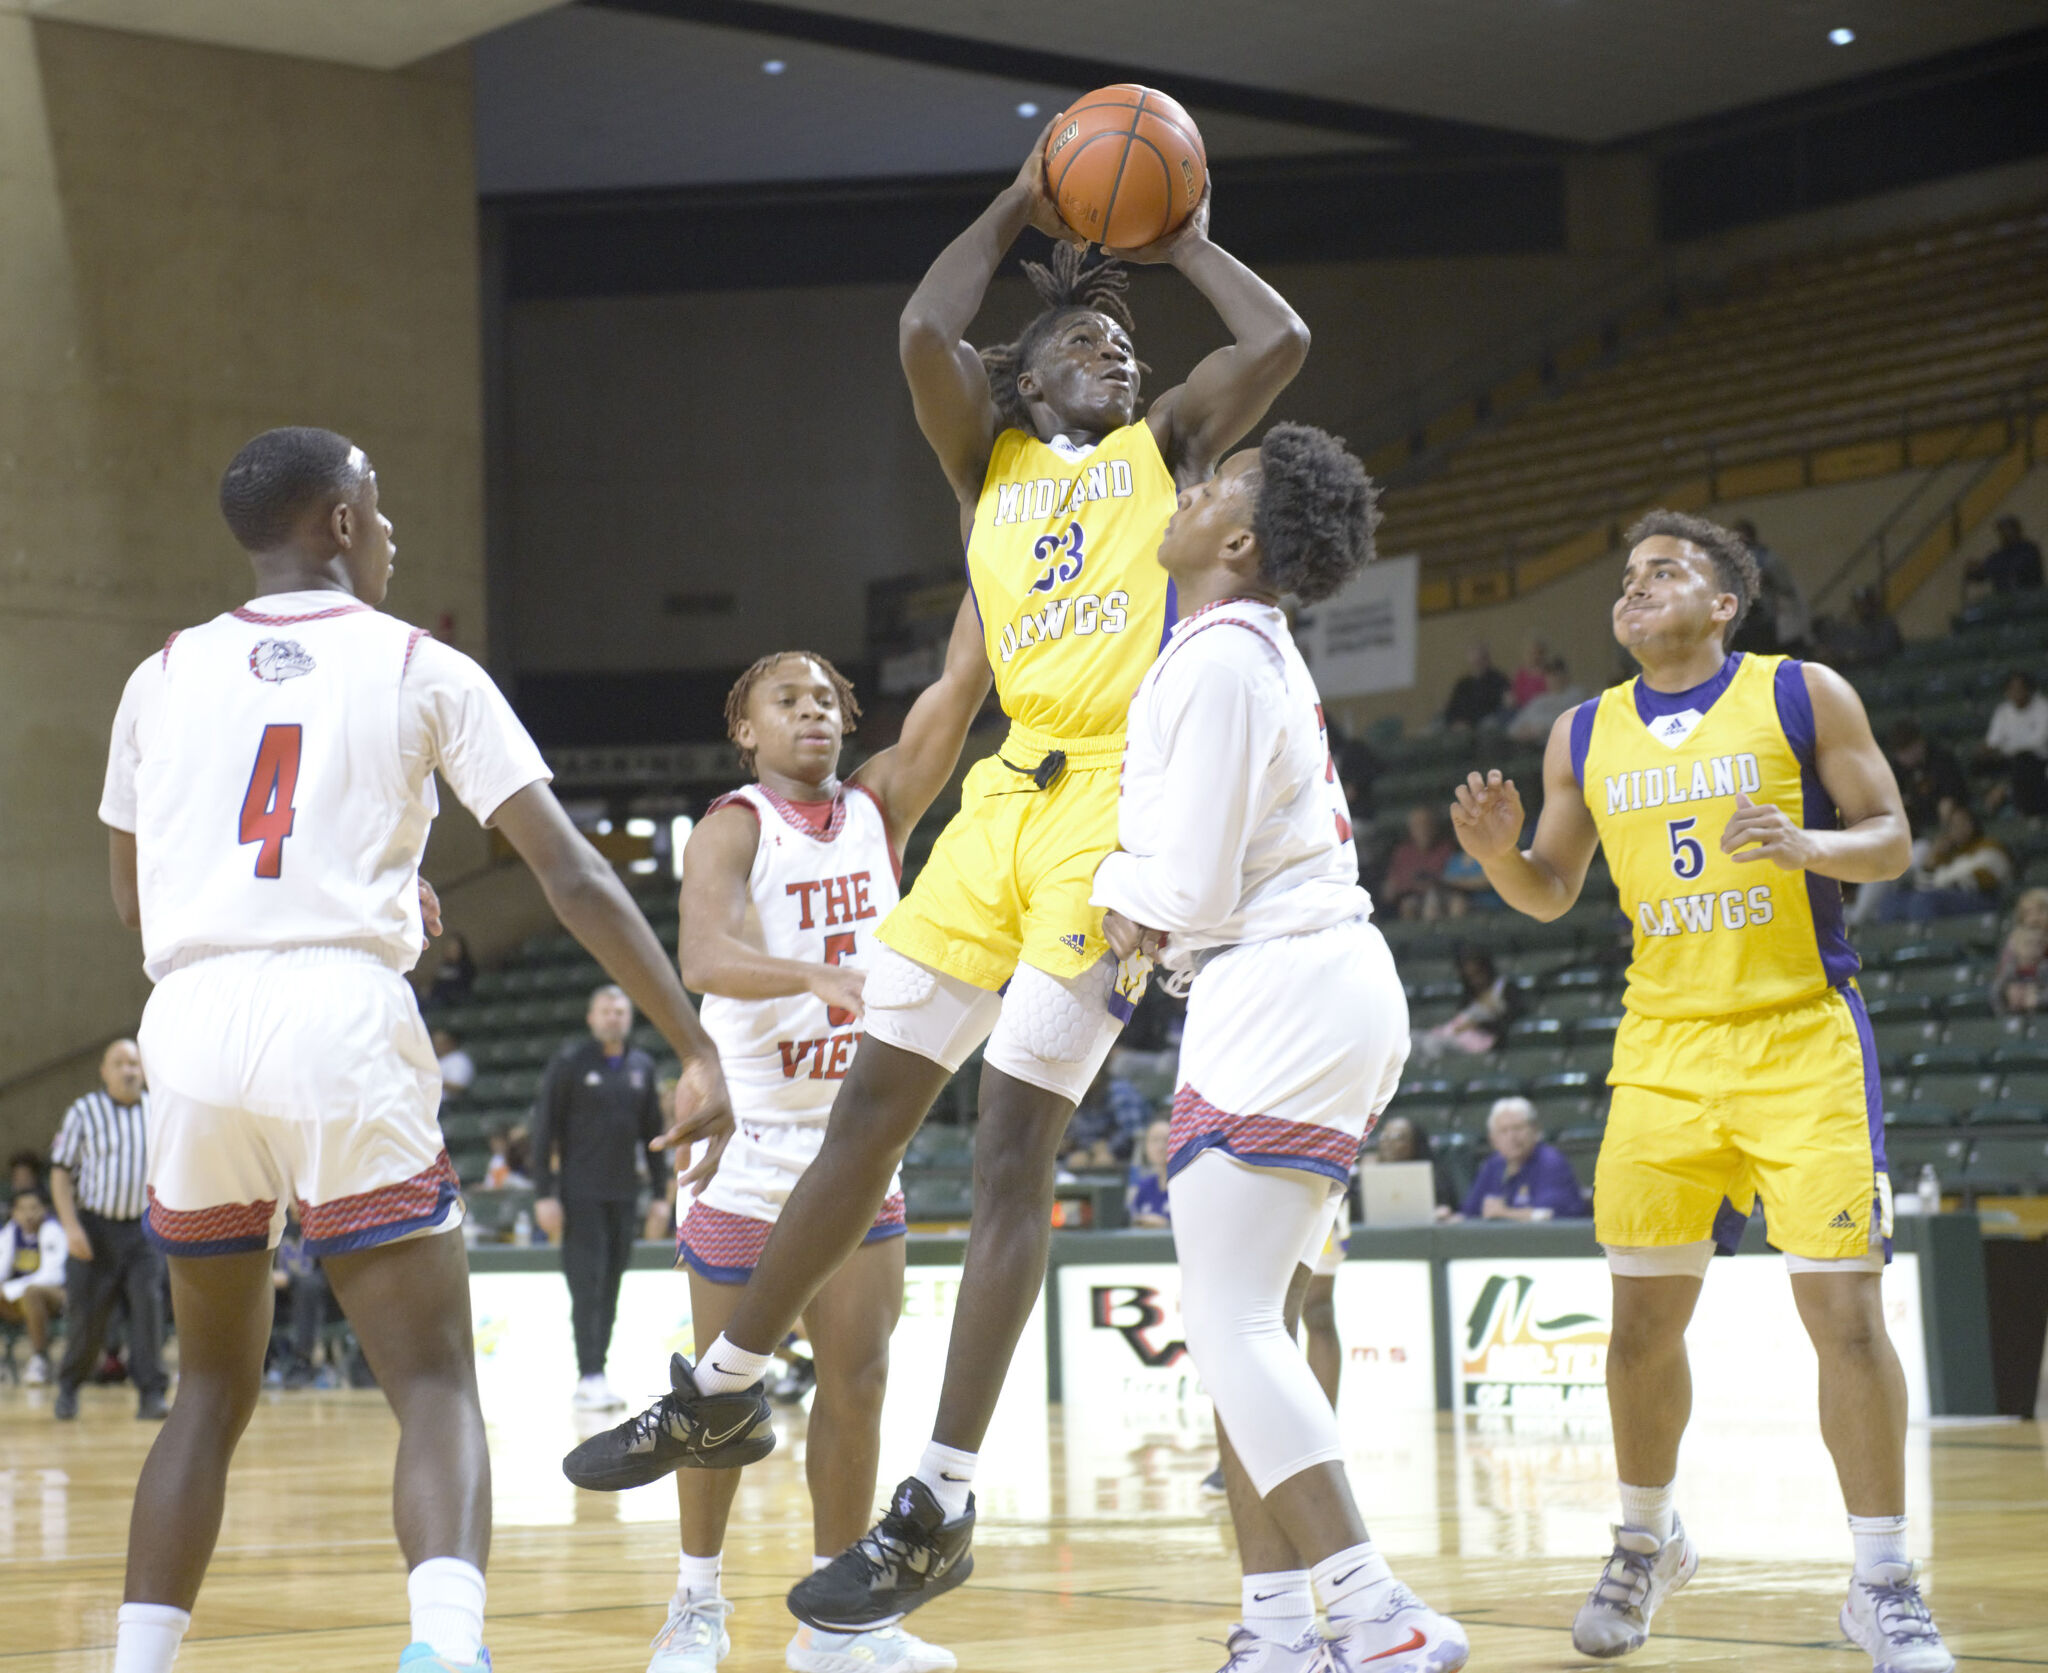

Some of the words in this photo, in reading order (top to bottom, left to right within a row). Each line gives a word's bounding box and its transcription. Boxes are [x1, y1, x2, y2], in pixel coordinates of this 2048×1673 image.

[994, 460, 1133, 526] MIDLAND
[1027, 520, 1085, 596] 23
[999, 590, 1130, 663] DAWGS
[238, 723, 303, 879] 4
[1604, 753, 1762, 816] MIDLAND
[1666, 816, 1705, 881] 5
[785, 870, 878, 931] THE
[1637, 885, 1774, 937] DAWGS
[778, 1031, 864, 1081] VIE
